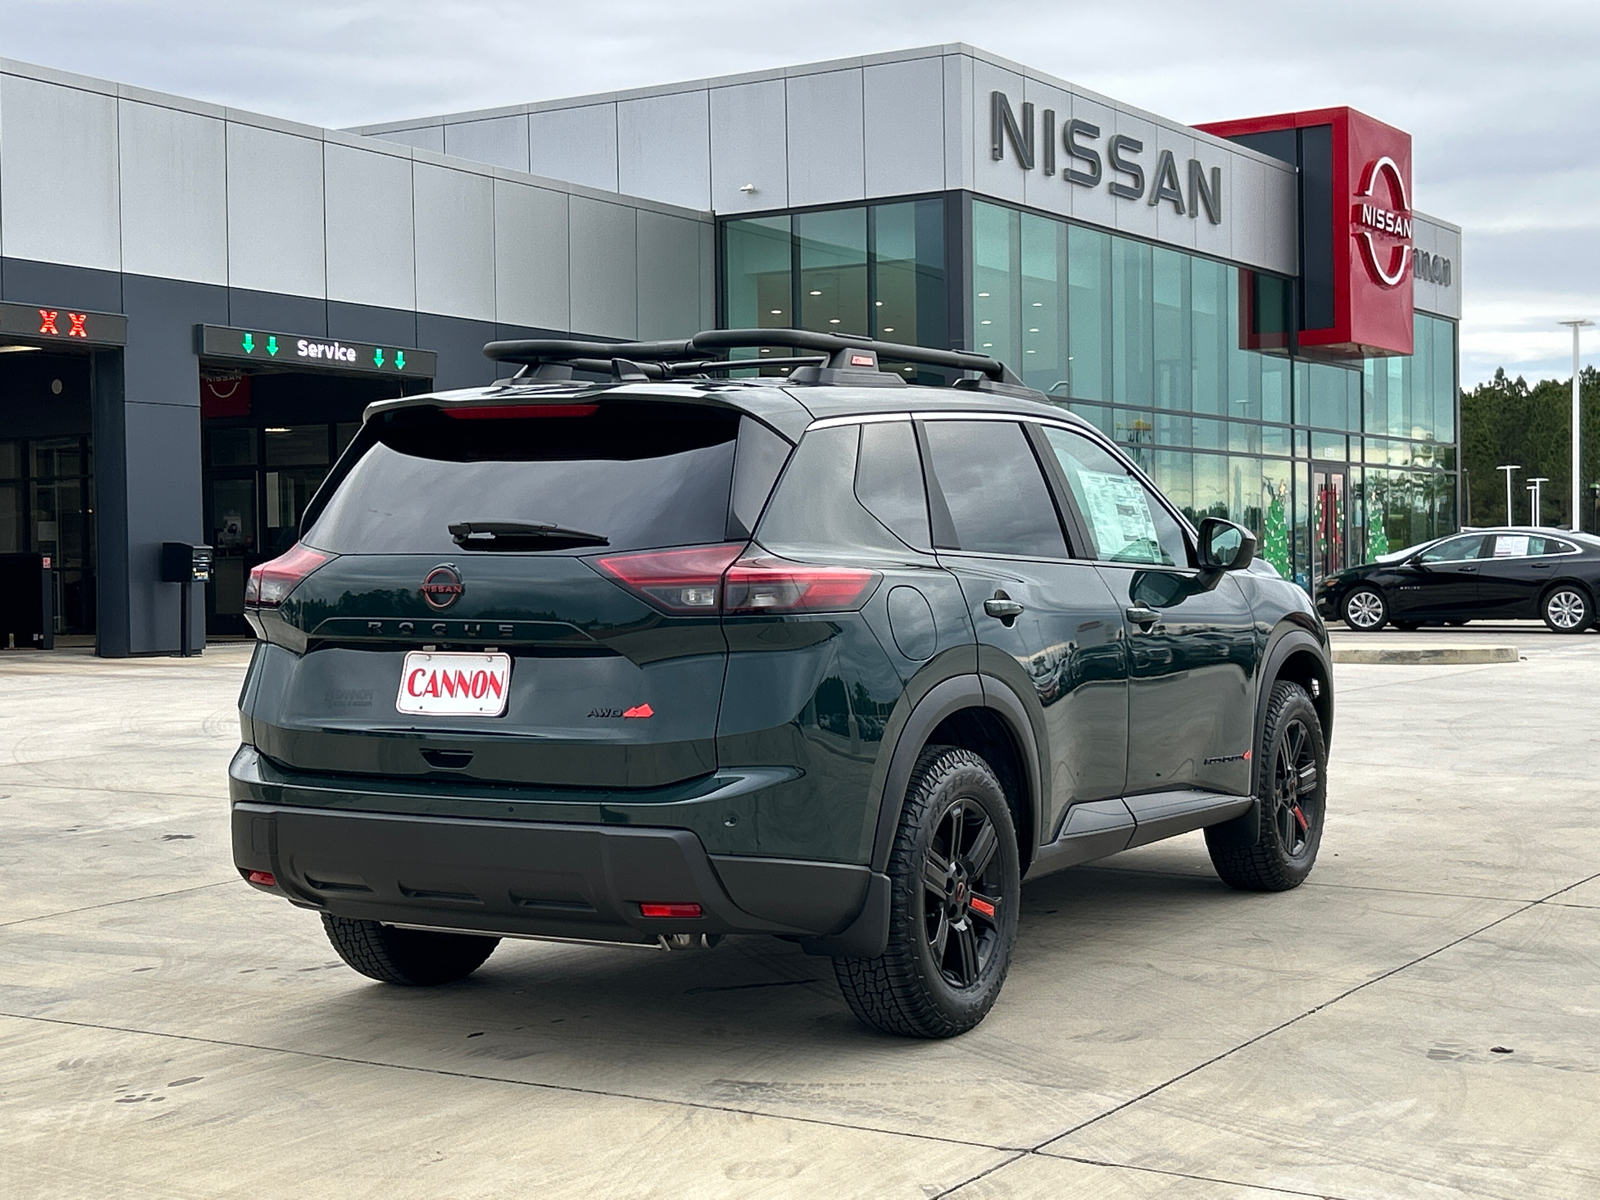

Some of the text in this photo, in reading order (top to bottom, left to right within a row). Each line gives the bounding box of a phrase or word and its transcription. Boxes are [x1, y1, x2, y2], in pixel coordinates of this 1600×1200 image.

[991, 90, 1221, 225] NISSAN
[1362, 203, 1412, 239] NISSAN
[297, 339, 357, 362] Service
[421, 584, 463, 594] NISSAN
[367, 620, 515, 637] ROGUE
[407, 668, 505, 699] CANNON
[587, 707, 623, 718] AWD
